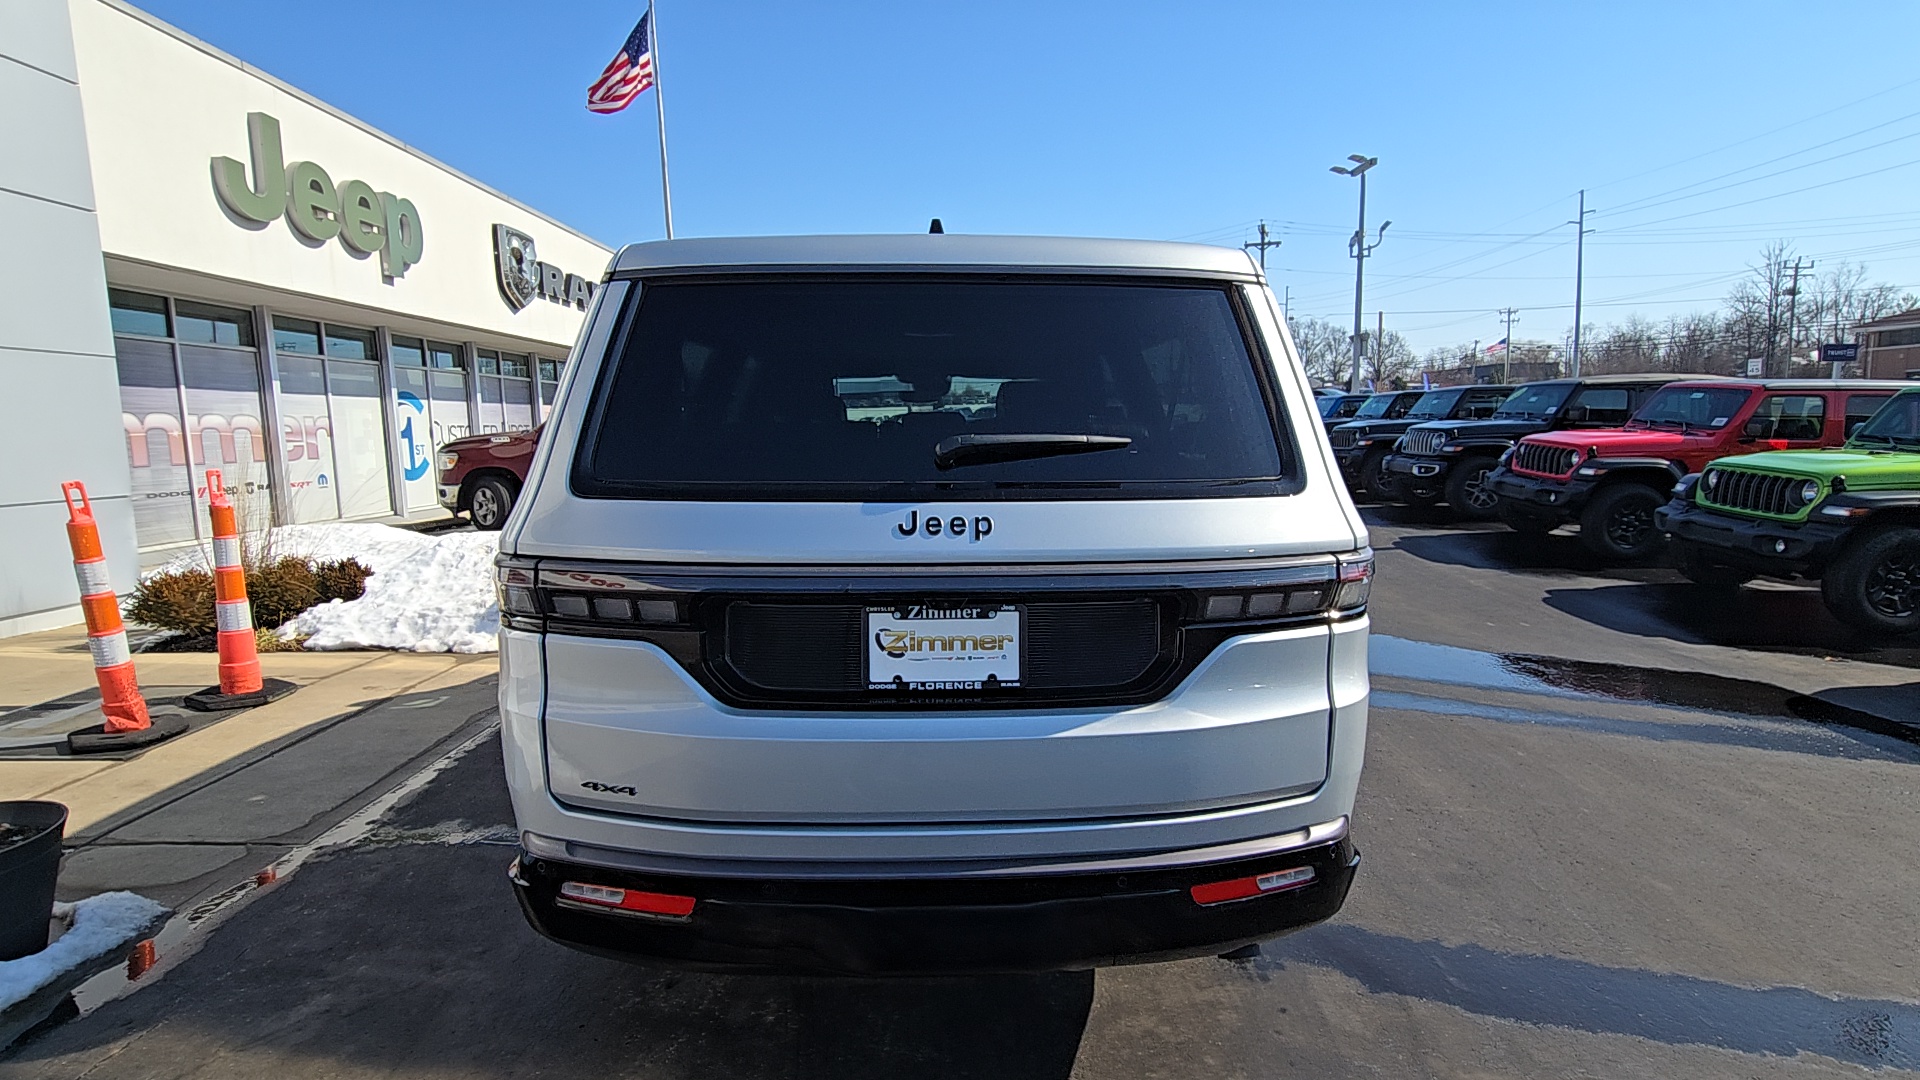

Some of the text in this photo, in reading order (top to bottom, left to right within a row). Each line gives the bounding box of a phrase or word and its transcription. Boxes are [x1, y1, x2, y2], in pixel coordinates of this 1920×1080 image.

[210, 112, 424, 279] Jeep
[538, 261, 600, 310] RA
[146, 490, 192, 499] DODG
[898, 510, 993, 541] Jeep
[908, 605, 981, 619] Zimmer
[884, 629, 1014, 652] Zimmer
[909, 682, 982, 690] FLORENCE
